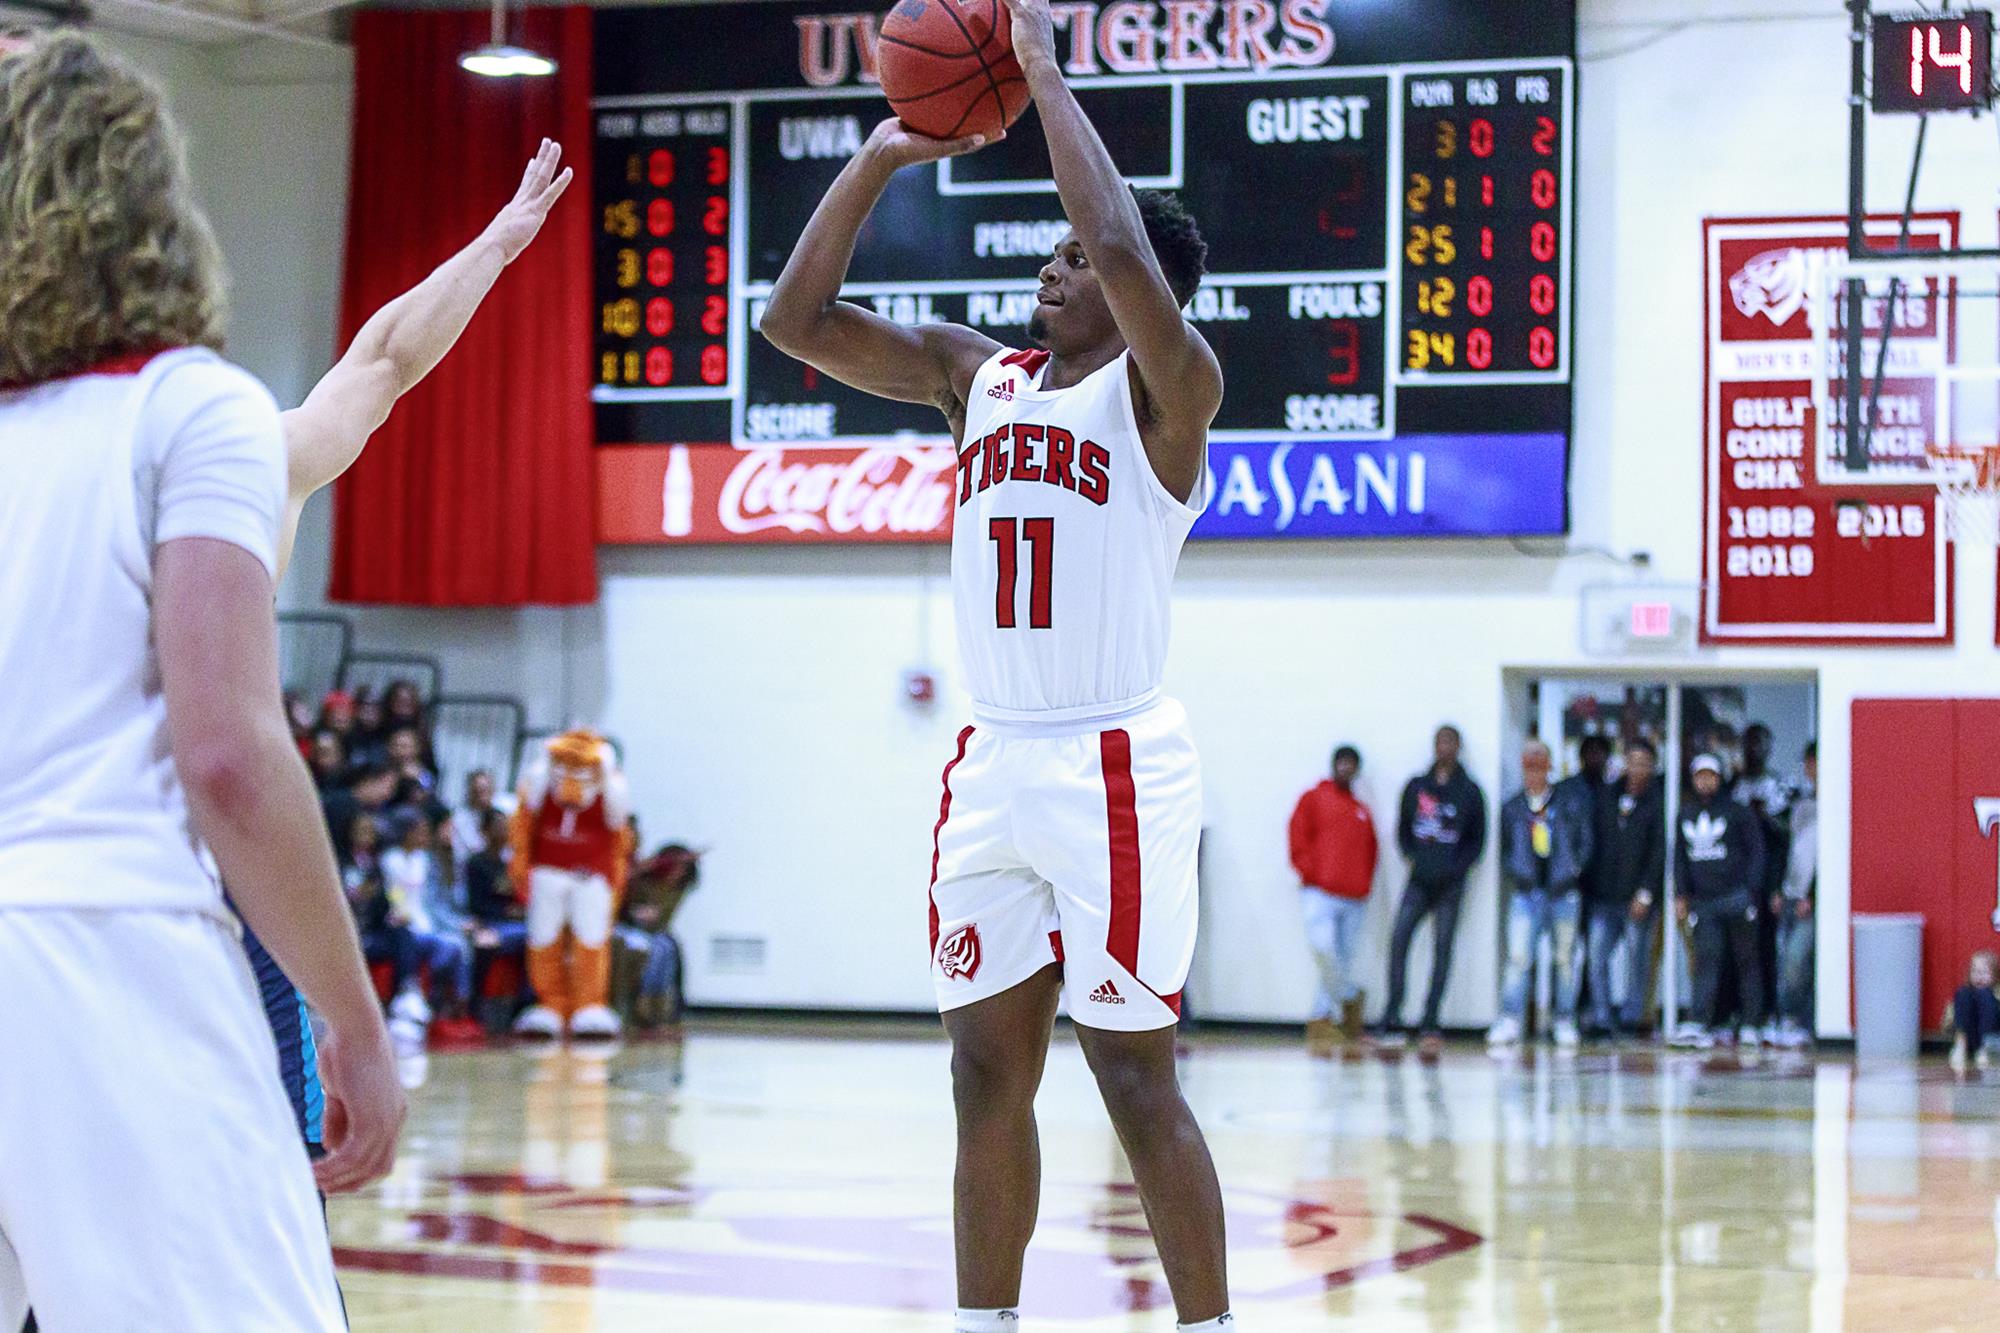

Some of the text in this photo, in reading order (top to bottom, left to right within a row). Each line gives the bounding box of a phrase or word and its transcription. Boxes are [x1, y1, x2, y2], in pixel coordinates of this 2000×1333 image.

[1910, 24, 1972, 96] 14
[1247, 96, 1370, 144] GUEST
[1436, 116, 1556, 158] 3 0 2
[648, 148, 674, 187] 0
[707, 146, 730, 186] 3
[1406, 169, 1556, 213] 21 1 0
[647, 197, 674, 237] 0
[703, 195, 728, 236] 2
[1406, 221, 1556, 265] 25 1 0
[617, 246, 728, 288] 3 0 3
[646, 297, 673, 337] 0
[702, 295, 727, 335] 2
[1289, 284, 1381, 320] FOULS
[1417, 274, 1555, 317] 12 0 0
[602, 344, 727, 386] 11 0 0
[1328, 320, 1360, 386] 3
[1408, 326, 1555, 369] 34 0 0
[748, 403, 836, 438] SCORE
[1284, 394, 1380, 431] SCORE
[958, 423, 1110, 507] TIGERS
[718, 447, 956, 534] Coca-Cola
[989, 517, 1054, 629] 11
[1089, 994, 1126, 1005] adidas
